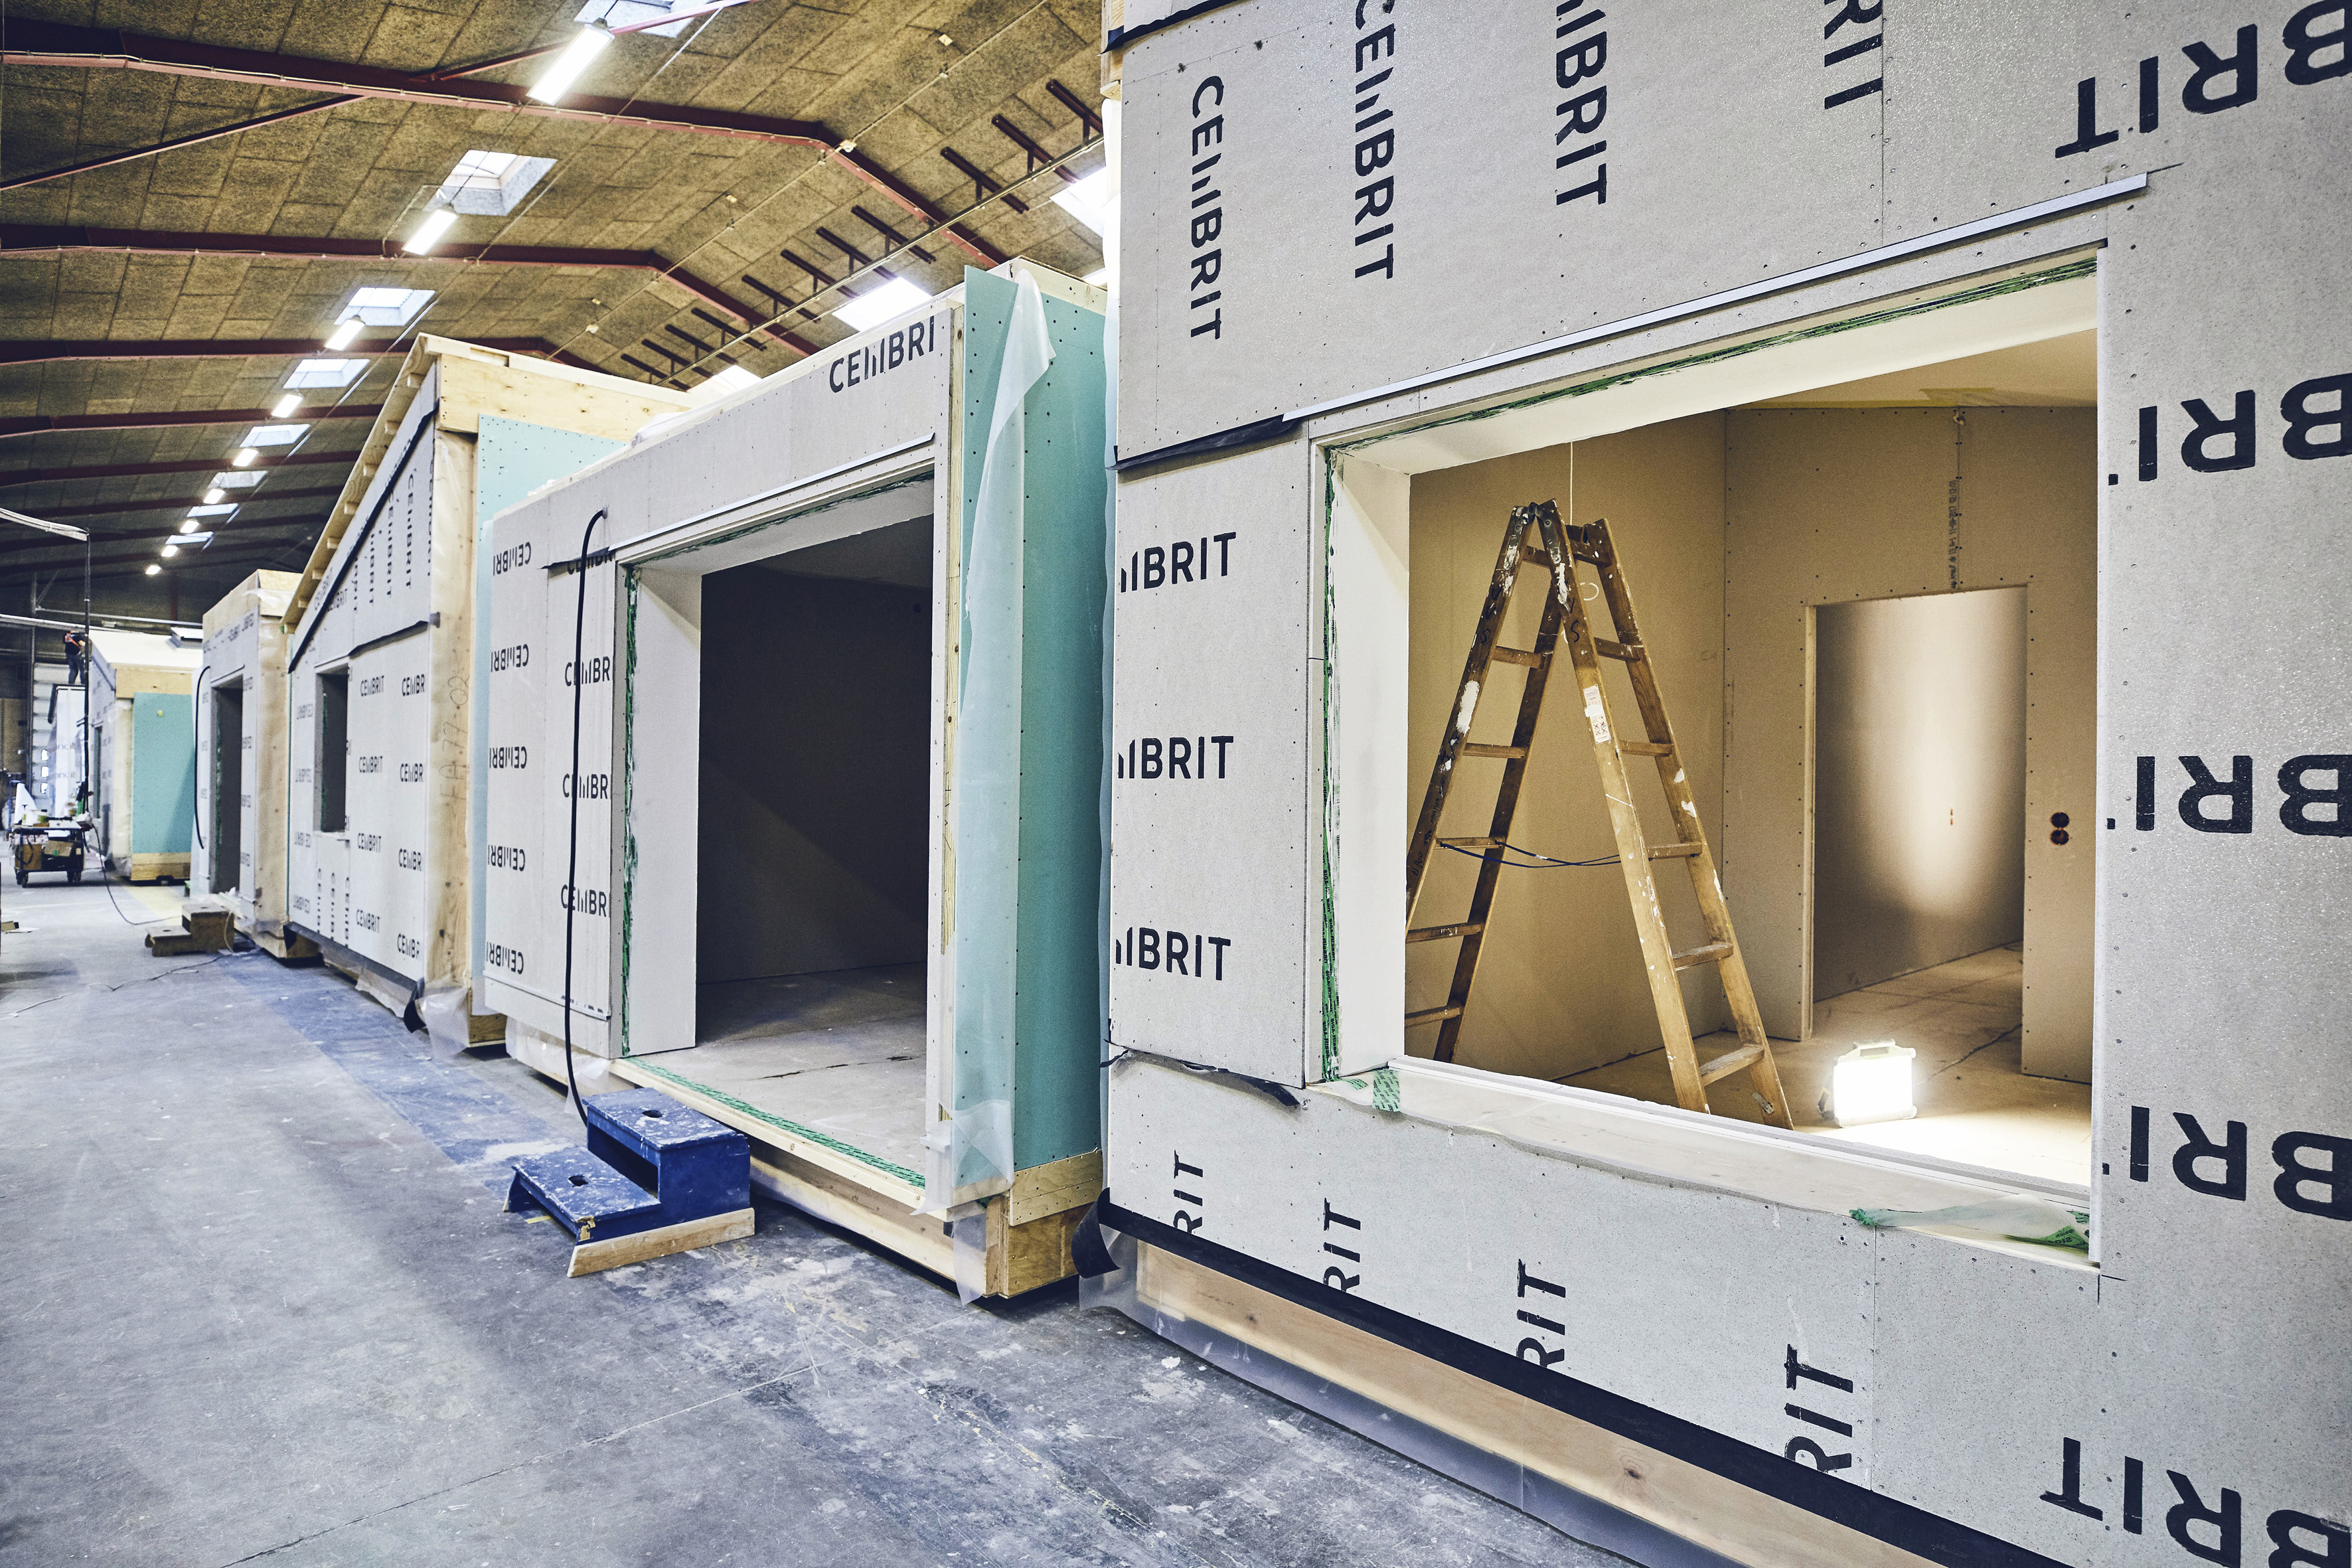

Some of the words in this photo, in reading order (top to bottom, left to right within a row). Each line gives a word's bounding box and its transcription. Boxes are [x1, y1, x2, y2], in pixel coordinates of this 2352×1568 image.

[1191, 76, 1224, 339] CEMBRIT
[830, 315, 934, 393] CEMBRI
[2108, 373, 2352, 486] BRI
[565, 657, 610, 686] CMBR
[563, 773, 608, 799] CMBR
[2106, 755, 2352, 838] BRI
[2102, 1105, 2352, 1221] BRI
